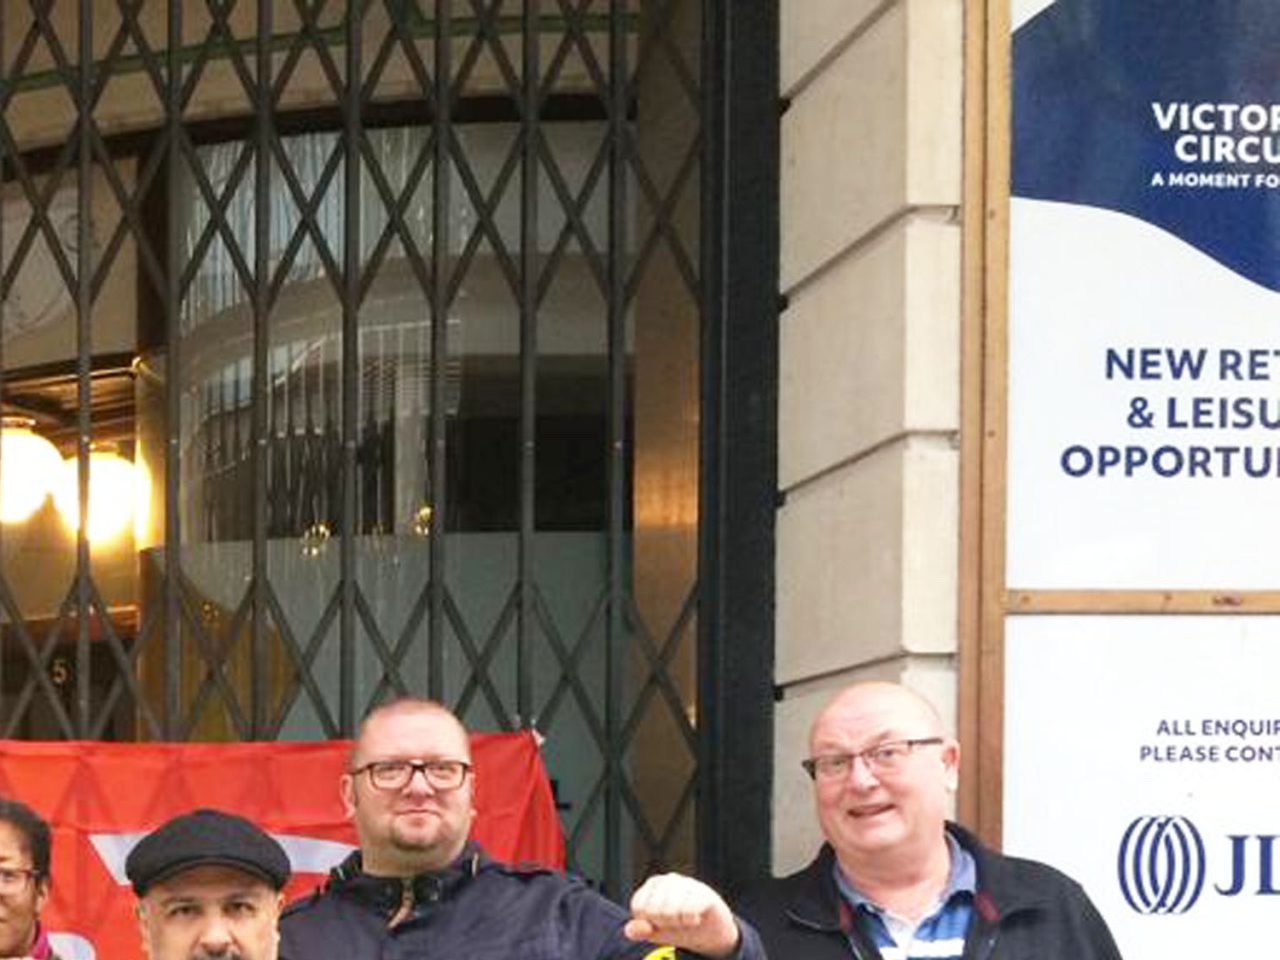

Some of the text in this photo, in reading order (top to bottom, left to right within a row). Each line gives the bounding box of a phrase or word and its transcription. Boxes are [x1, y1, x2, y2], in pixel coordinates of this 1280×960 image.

[1174, 134, 1280, 164] CIRCU
[1152, 172, 1164, 187] A
[1169, 172, 1250, 188] MOMENT
[1106, 348, 1207, 380] NEW
[1127, 397, 1280, 429] & LEISU
[1060, 445, 1280, 478] OPPORTU
[1156, 719, 1196, 736] ALL
[1140, 745, 1220, 762] PLEASE
